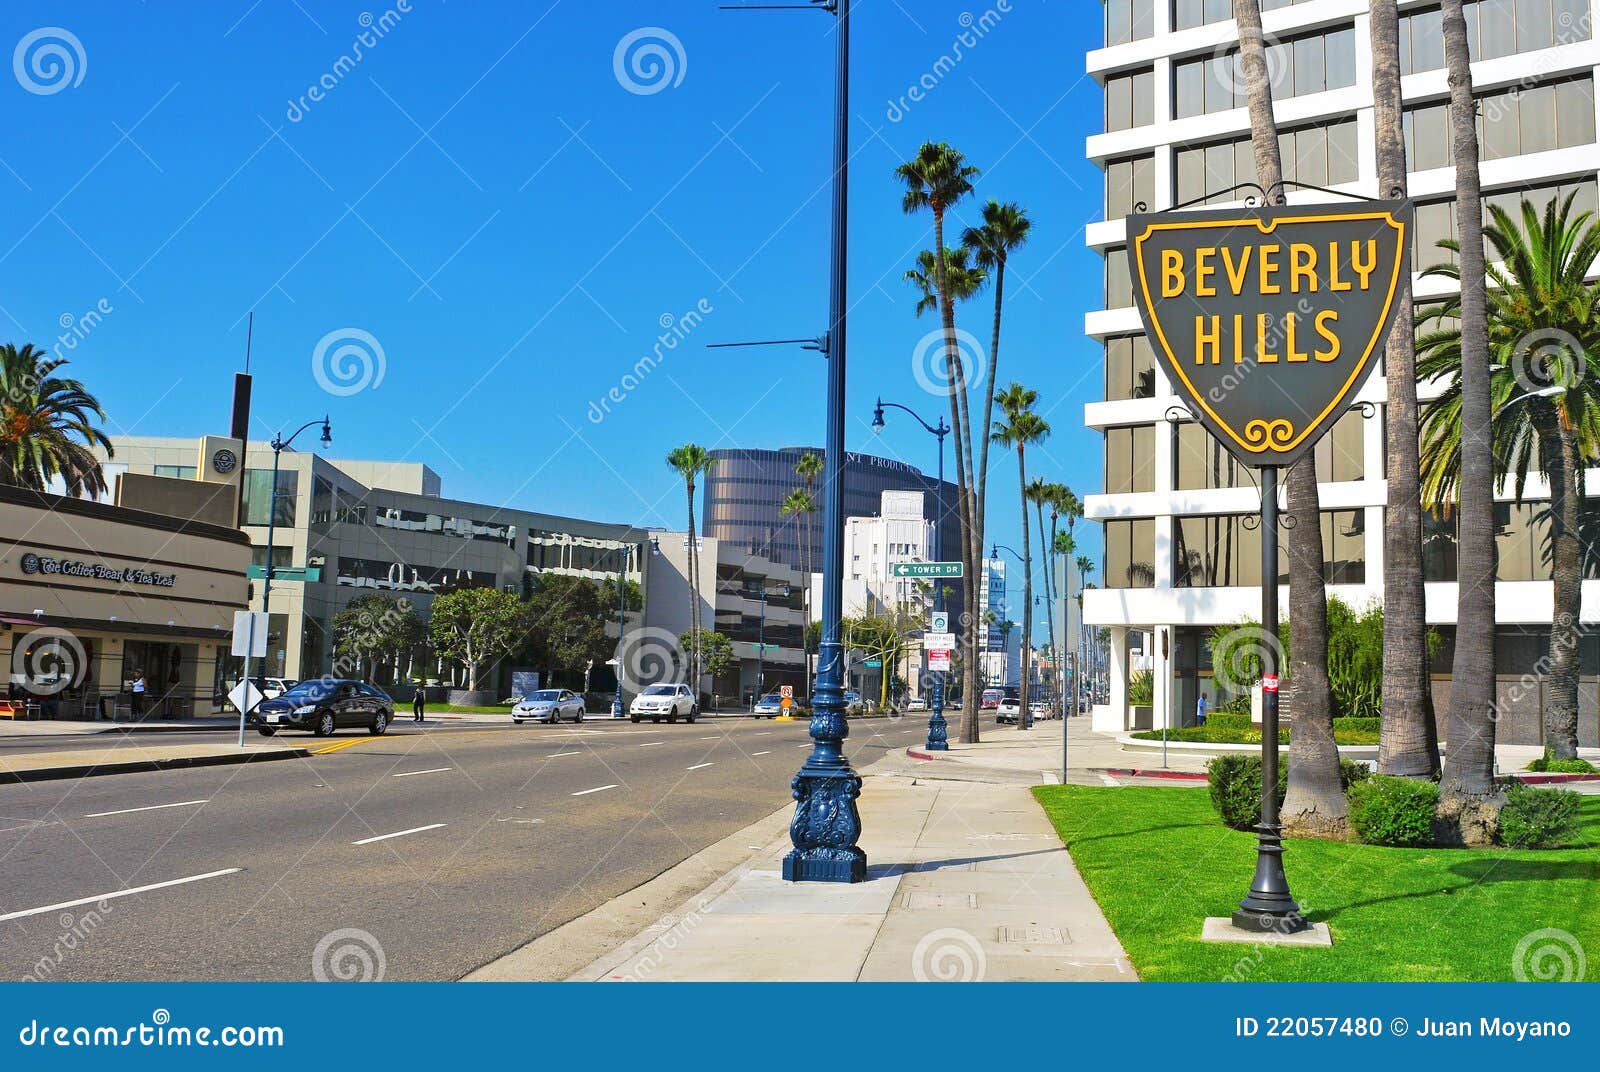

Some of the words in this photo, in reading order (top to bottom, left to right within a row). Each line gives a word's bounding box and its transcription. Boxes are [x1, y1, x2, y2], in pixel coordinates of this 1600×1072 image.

[1161, 239, 1377, 299] BEVERLY
[1195, 309, 1341, 366] HILLS
[846, 452, 863, 463] NT
[41, 558, 61, 574] The
[62, 560, 96, 577] Coffee
[95, 565, 124, 582] Bean
[126, 569, 136, 581] &
[135, 571, 153, 584] Tea
